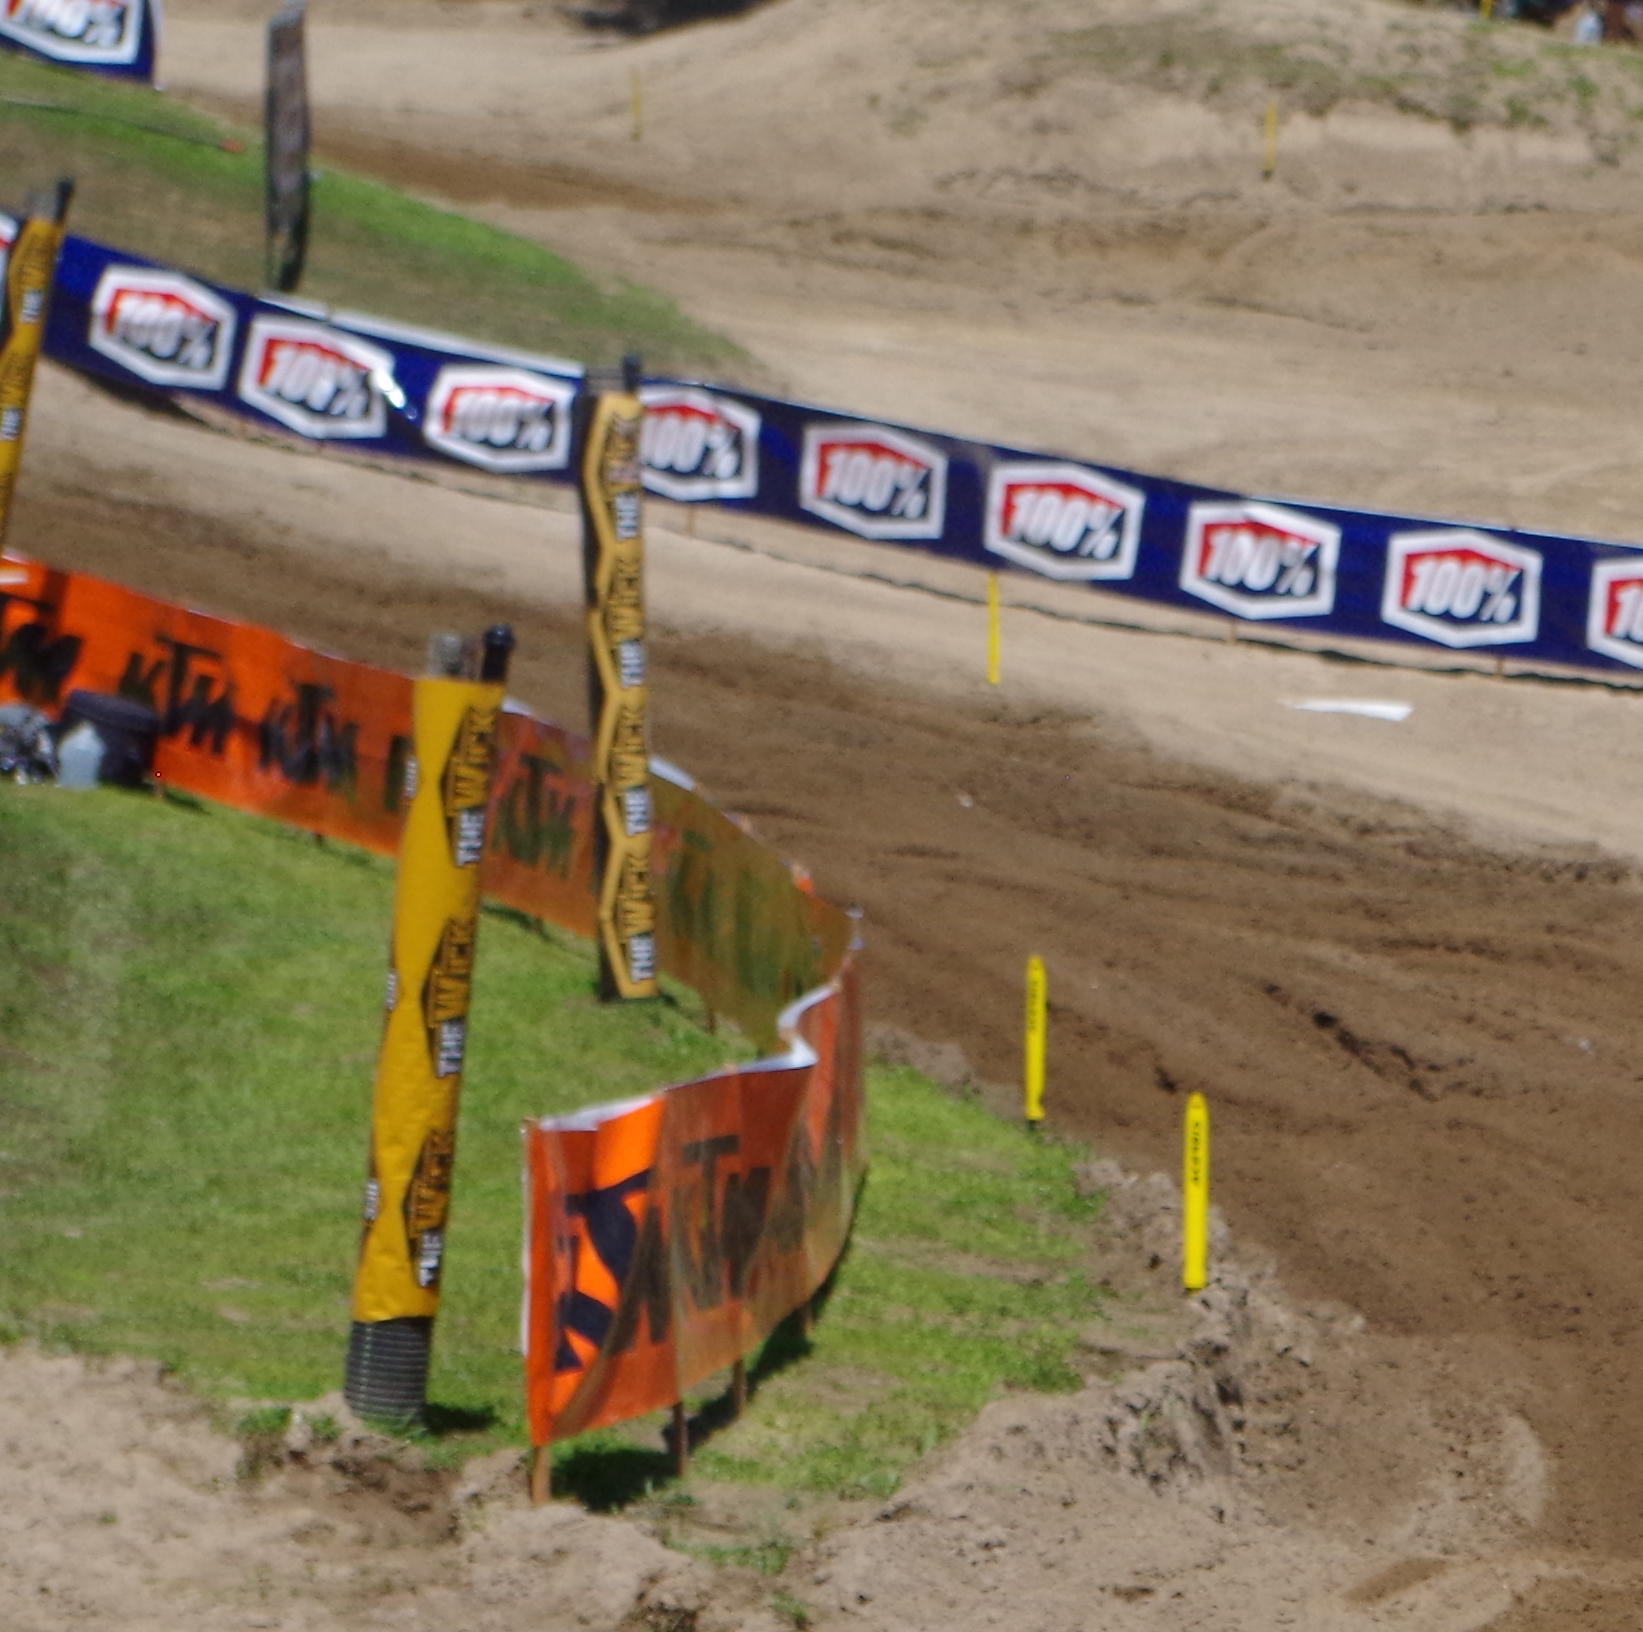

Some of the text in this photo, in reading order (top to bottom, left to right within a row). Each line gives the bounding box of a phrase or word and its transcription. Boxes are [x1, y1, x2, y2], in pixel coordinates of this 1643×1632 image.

[113, 297, 214, 372] 100%
[261, 346, 374, 421] 100%
[449, 390, 553, 452] 100%
[822, 451, 930, 520] 100%
[1007, 488, 1126, 560] 100%
[1204, 528, 1316, 597] 100%
[1405, 559, 1521, 624] 100%
[455, 810, 485, 867] THE
[437, 1020, 466, 1078] THE
